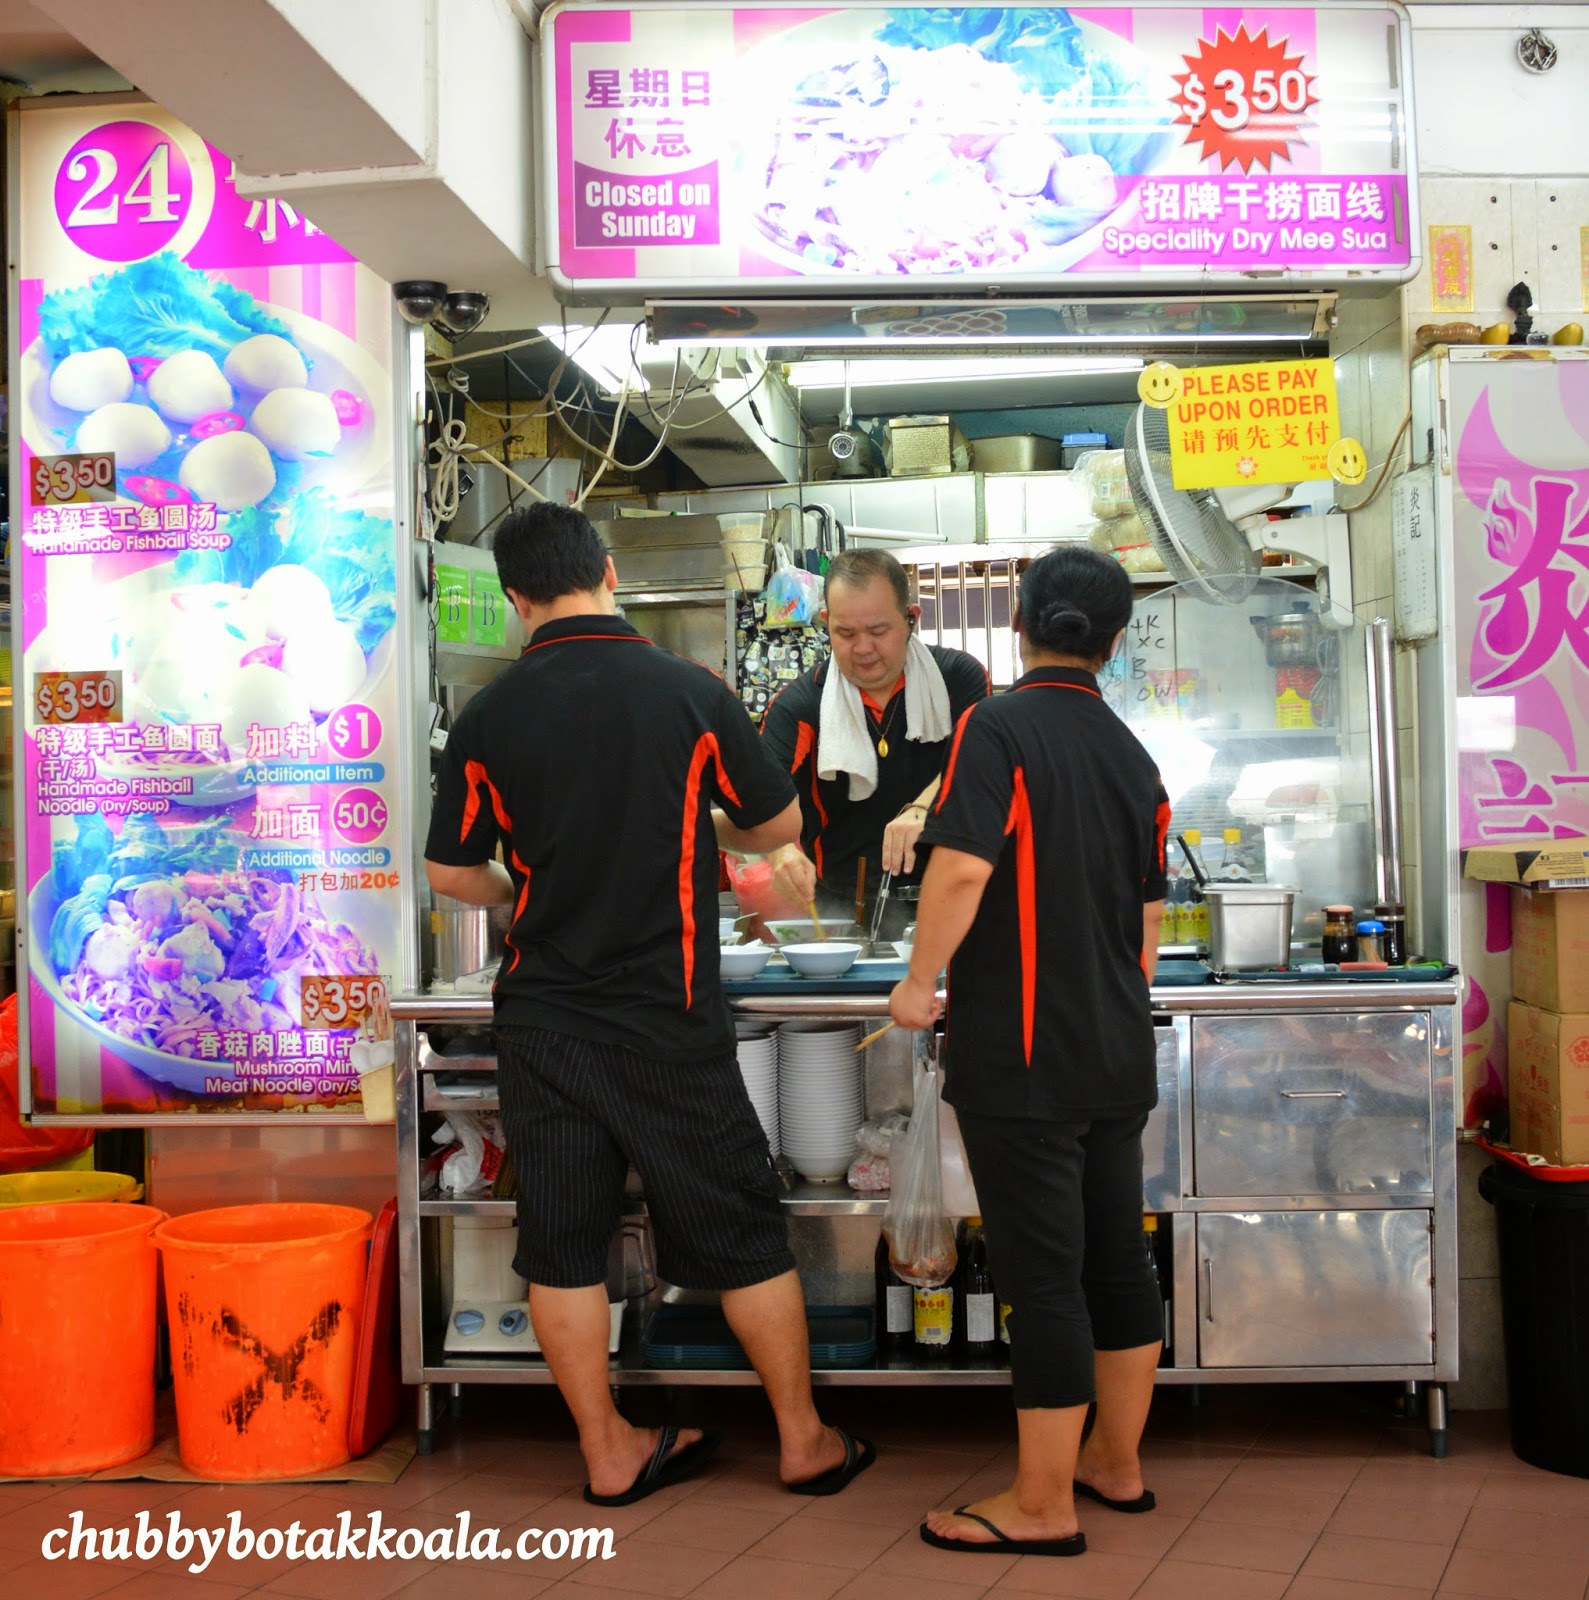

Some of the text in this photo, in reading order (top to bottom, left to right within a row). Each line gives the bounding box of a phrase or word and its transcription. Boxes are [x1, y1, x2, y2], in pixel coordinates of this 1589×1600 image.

[584, 67, 710, 108] 星期日
[66, 143, 181, 228] 24
[585, 181, 711, 208] Closed on
[1141, 181, 1386, 223] 招牌干捞面线
[601, 210, 697, 239] Sunday
[1103, 226, 1388, 257] Speciality Dry Mee Sua
[1182, 368, 1318, 397] PLEASE PAY
[1178, 394, 1329, 423] UPON ORDER
[1181, 420, 1330, 455] 请预先支付
[125, 533, 185, 552] Fishball
[188, 531, 232, 551] Soup
[482, 591, 496, 627] B
[36, 723, 221, 756] 特级手工鱼圆面
[247, 711, 370, 759] 加料 $1
[37, 776, 193, 797] Handmade Fishball
[243, 764, 373, 783] Additional Item
[38, 797, 171, 815] Noodle (Dry/Soup)
[250, 801, 387, 840] 加面 50¢
[249, 850, 386, 867] Additional Noodle
[234, 1060, 322, 1077] Mushroom
[205, 1078, 250, 1094] Meat
[253, 1077, 314, 1094] Noodle
